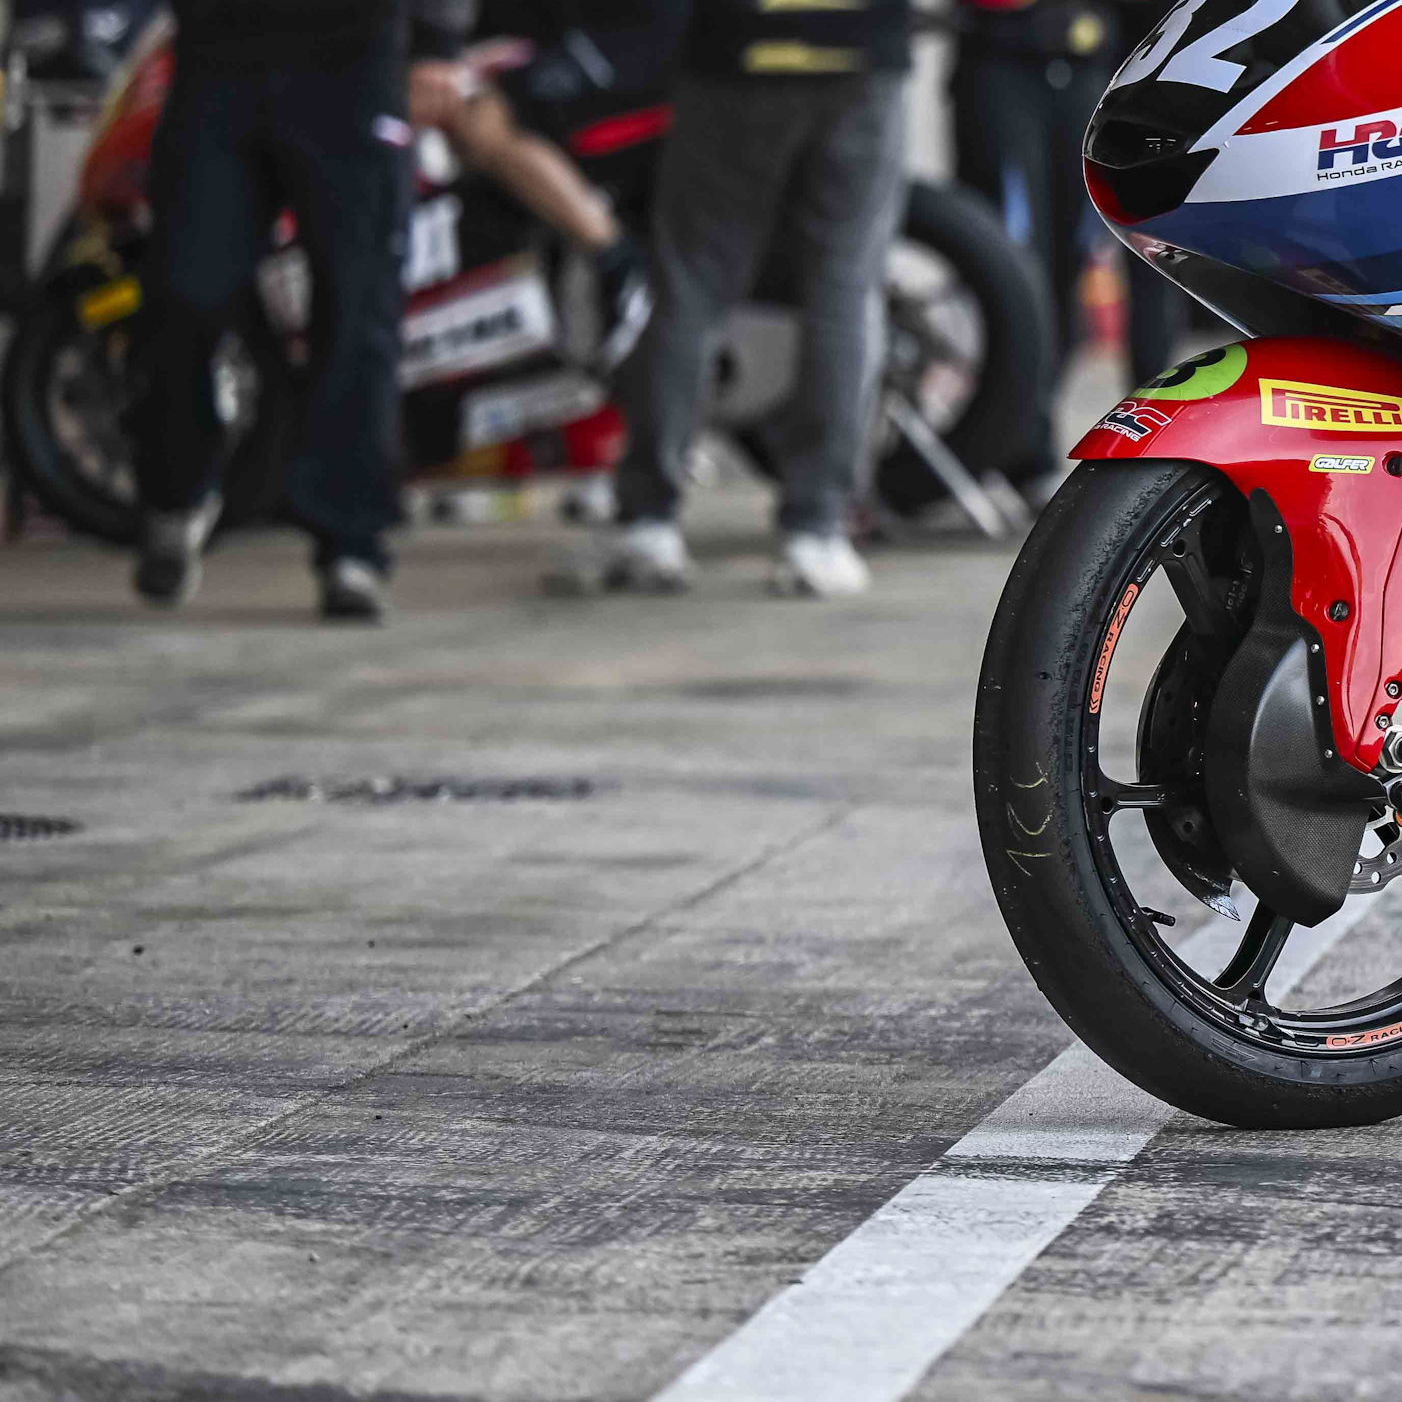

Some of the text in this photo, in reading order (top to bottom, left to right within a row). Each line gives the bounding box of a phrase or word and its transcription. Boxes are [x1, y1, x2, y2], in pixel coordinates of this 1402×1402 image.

[1317, 165, 1377, 181] Honda
[1271, 387, 1402, 425] PIRELLI
[1100, 423, 1141, 443] RACING
[1314, 456, 1371, 472] GALFER
[1093, 631, 1115, 693] RACING
